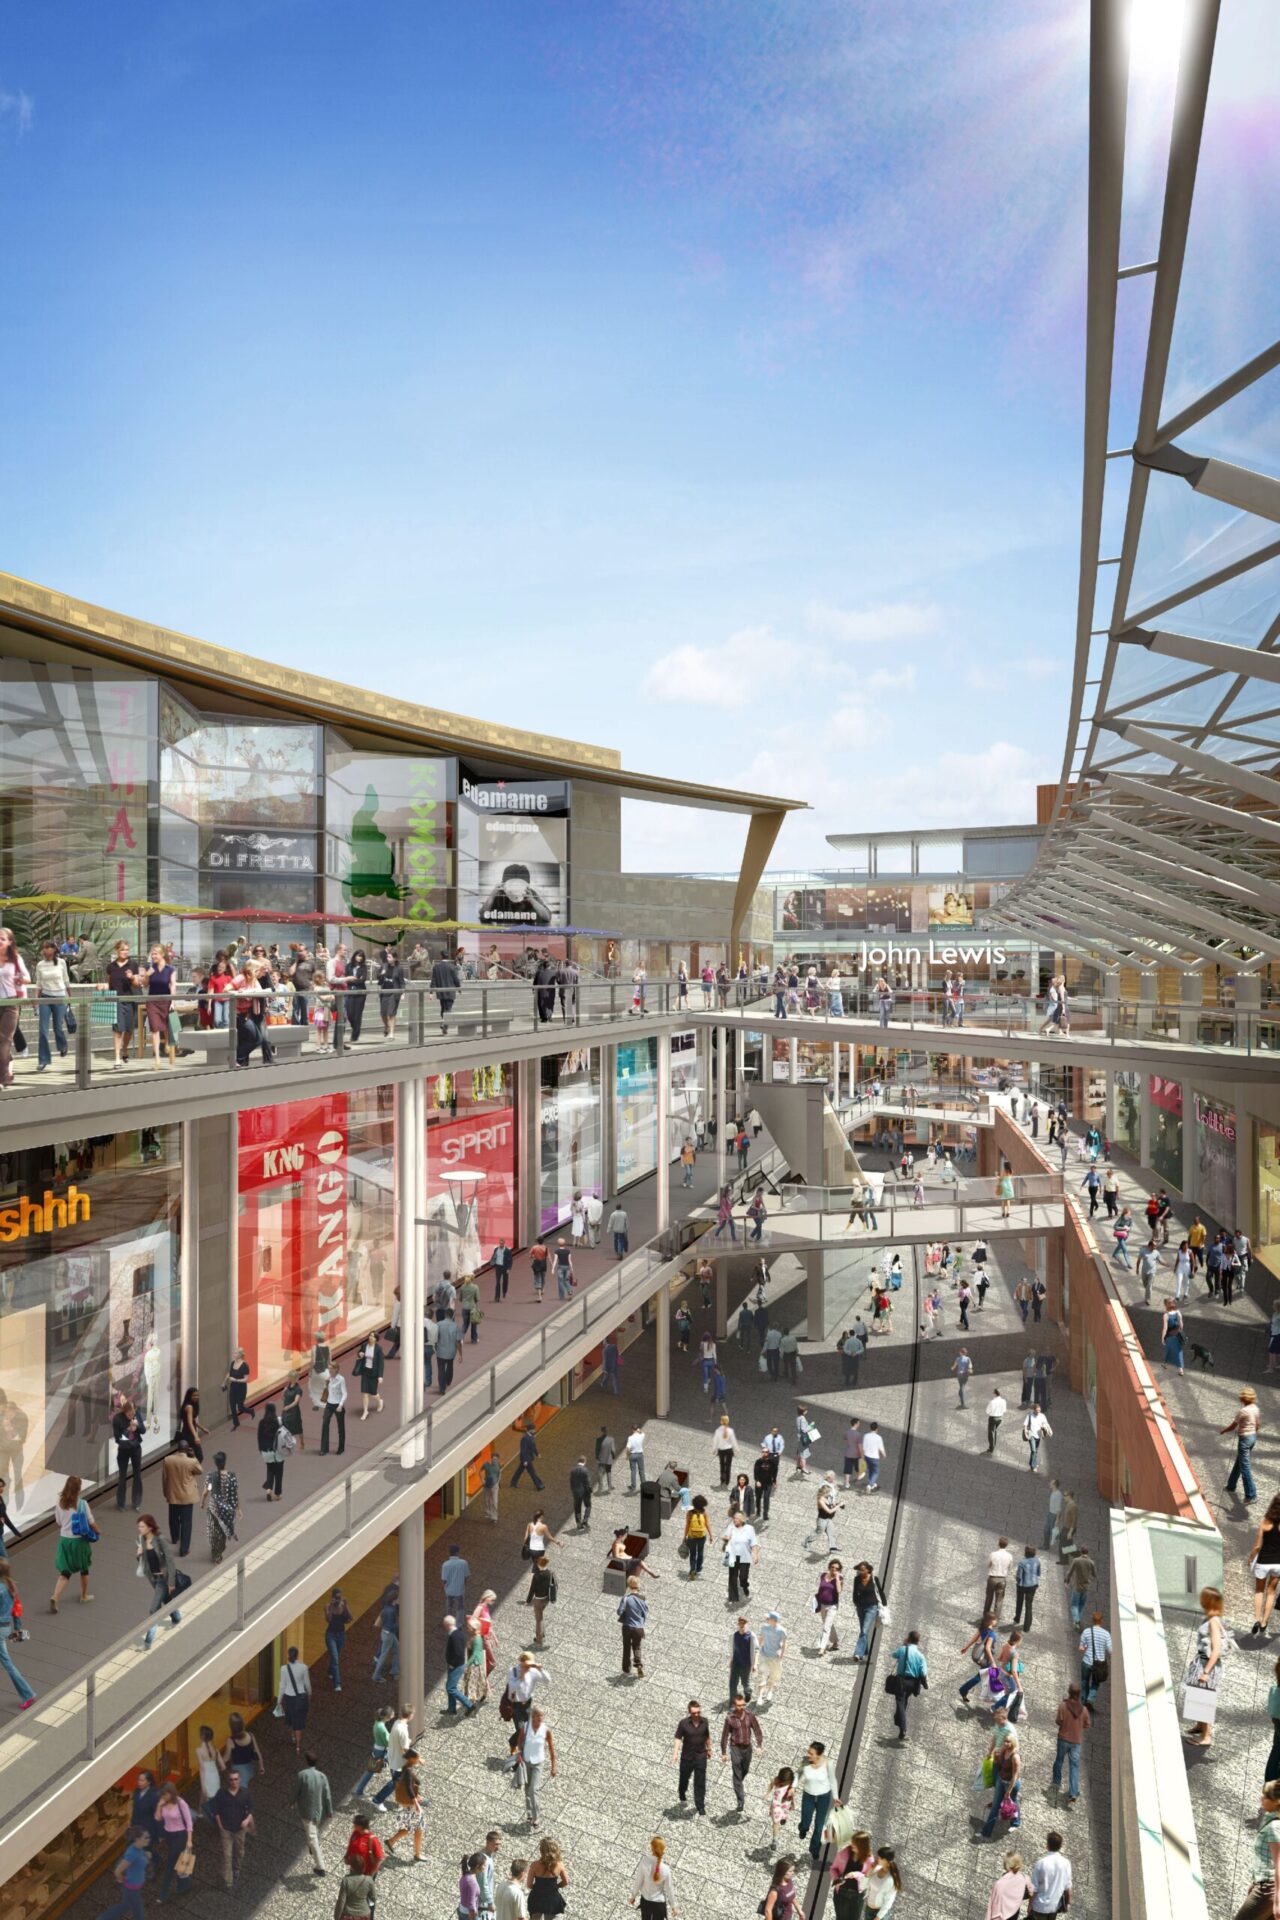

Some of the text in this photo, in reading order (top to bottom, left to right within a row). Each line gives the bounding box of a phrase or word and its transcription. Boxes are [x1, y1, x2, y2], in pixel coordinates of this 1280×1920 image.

[106, 687, 138, 902] THAI
[463, 778, 548, 811] edamame
[209, 852, 314, 870] DI FRETTA
[408, 763, 437, 922] KOMODO
[483, 909, 537, 920] edamame
[859, 938, 1007, 972] John Lewis
[263, 1142, 305, 1178] KNG
[440, 1121, 512, 1165] SPRIT
[0, 1185, 91, 1242] shhh
[317, 1130, 344, 1328] KANGO
